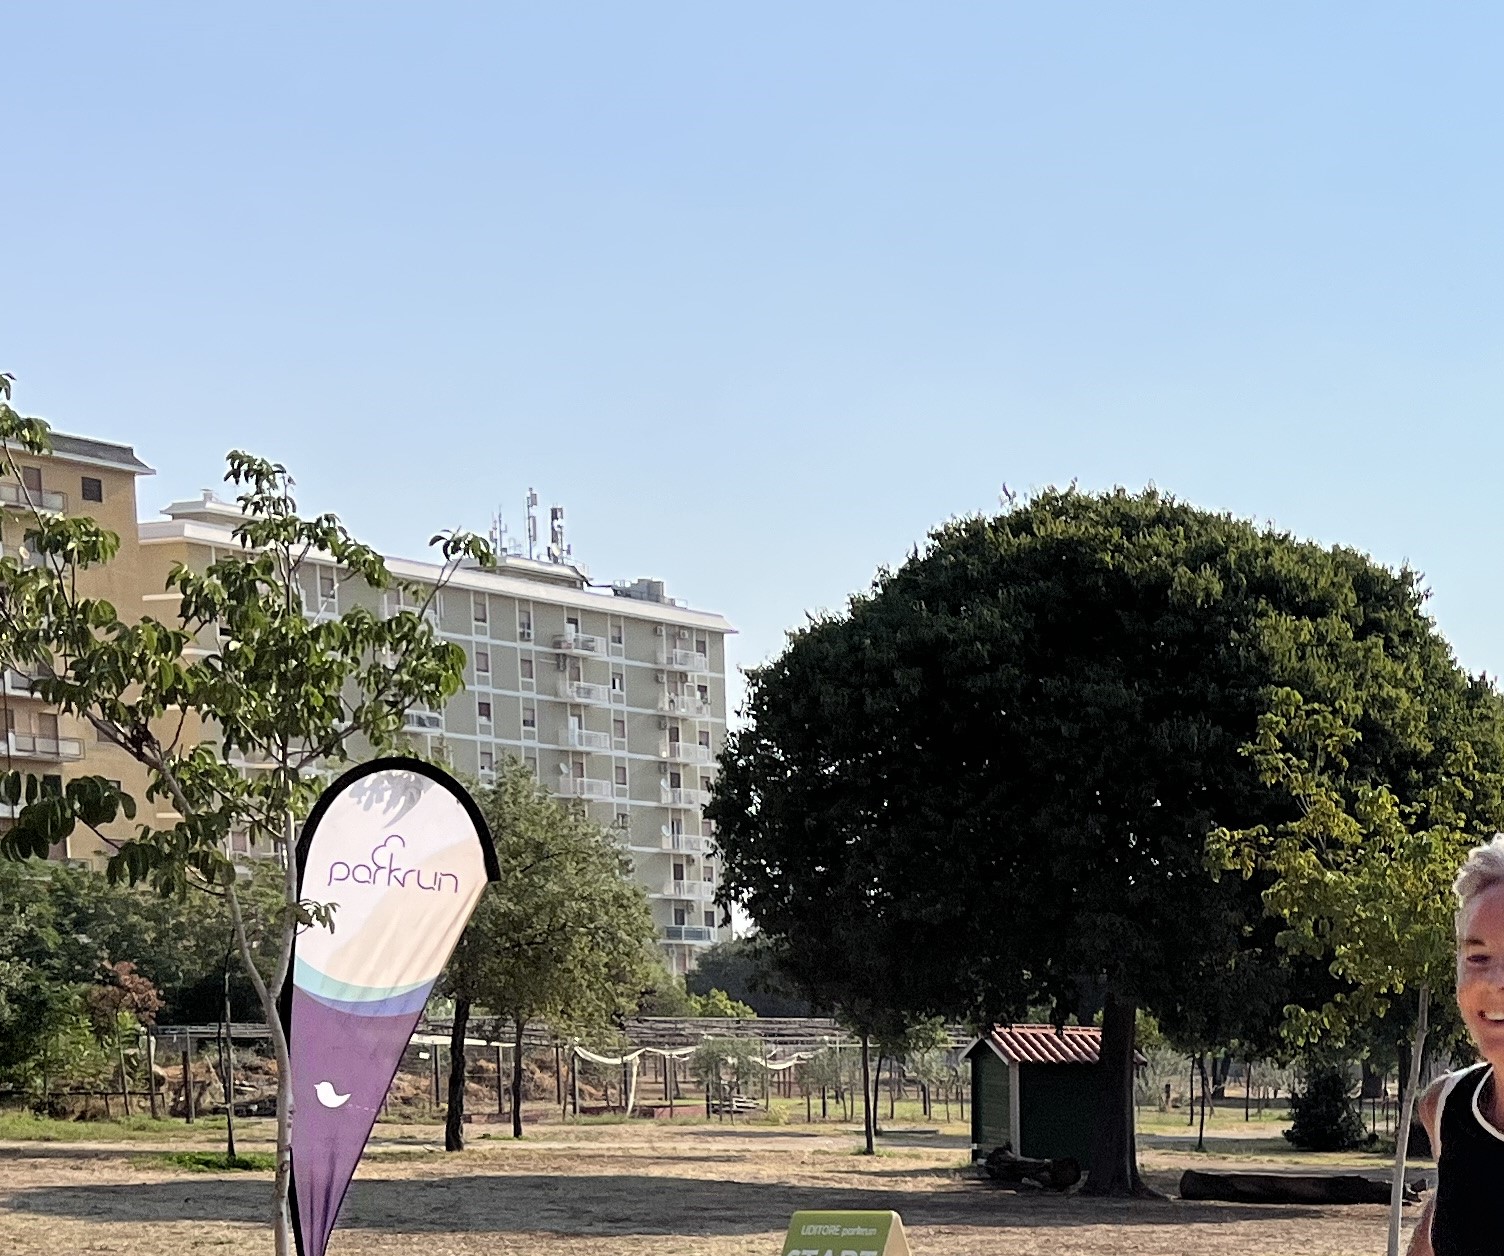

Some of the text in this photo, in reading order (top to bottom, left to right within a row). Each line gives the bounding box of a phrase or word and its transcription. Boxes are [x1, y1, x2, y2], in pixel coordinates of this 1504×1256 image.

[328, 836, 459, 893] parkrun
[801, 1224, 877, 1237] UDITORE parkrun
